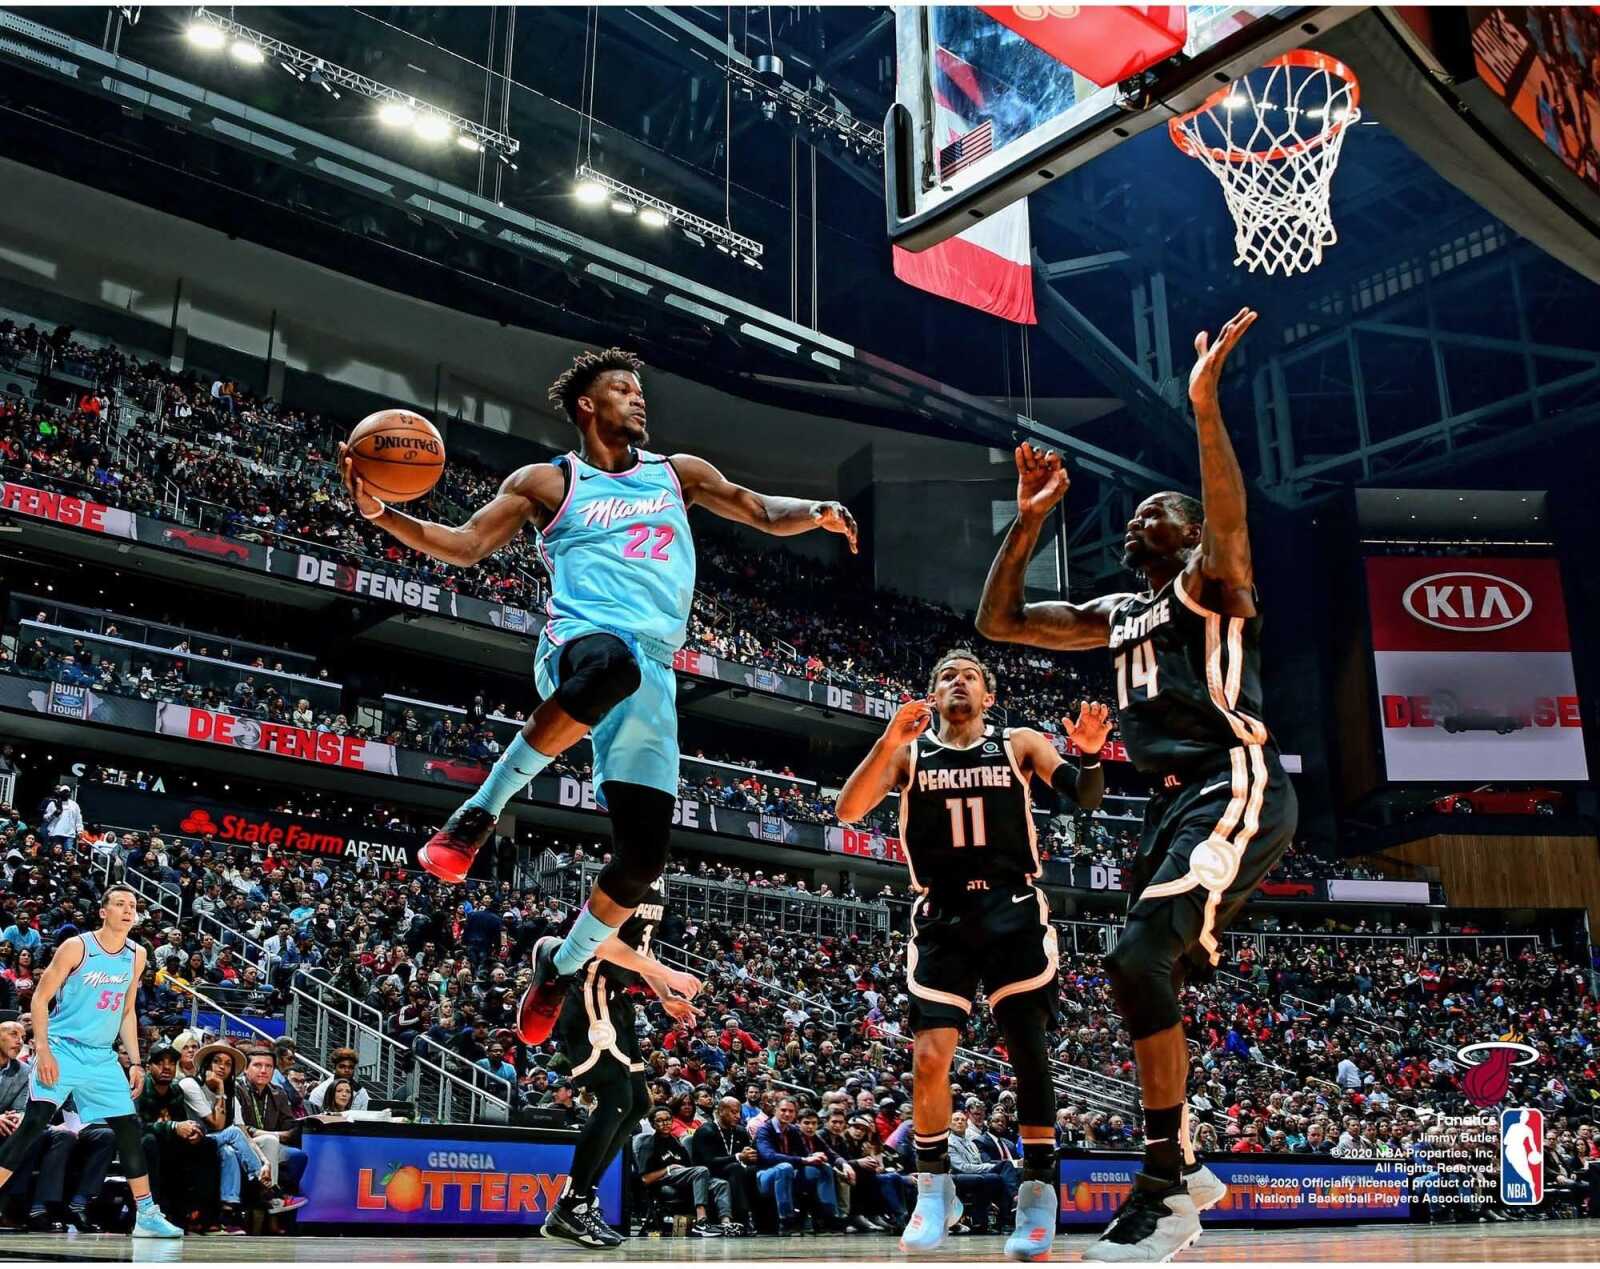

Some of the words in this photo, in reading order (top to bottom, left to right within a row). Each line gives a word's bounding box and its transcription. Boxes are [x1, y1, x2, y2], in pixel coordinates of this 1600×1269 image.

[374, 435, 439, 456] SPALDING
[577, 489, 675, 528] Miami
[624, 524, 674, 560] 22
[1424, 586, 1514, 618] KIA
[1114, 640, 1158, 710] 14
[55, 683, 85, 698] BUILT
[53, 704, 83, 717] TOUGH
[865, 696, 898, 719] FEN
[918, 766, 1011, 792] PEACHTREE
[945, 797, 986, 848] 11
[220, 815, 283, 844] State
[285, 825, 344, 854] Farm
[344, 840, 408, 864] ARENA
[967, 880, 990, 891] ATL
[83, 970, 128, 988] Miami
[96, 990, 124, 1012] 55
[214, 1028, 250, 1037] GORGIA
[428, 1152, 495, 1169] GEORGIA
[1090, 1172, 1131, 1182] GEORGIA
[357, 1166, 569, 1213] LOTTERY
